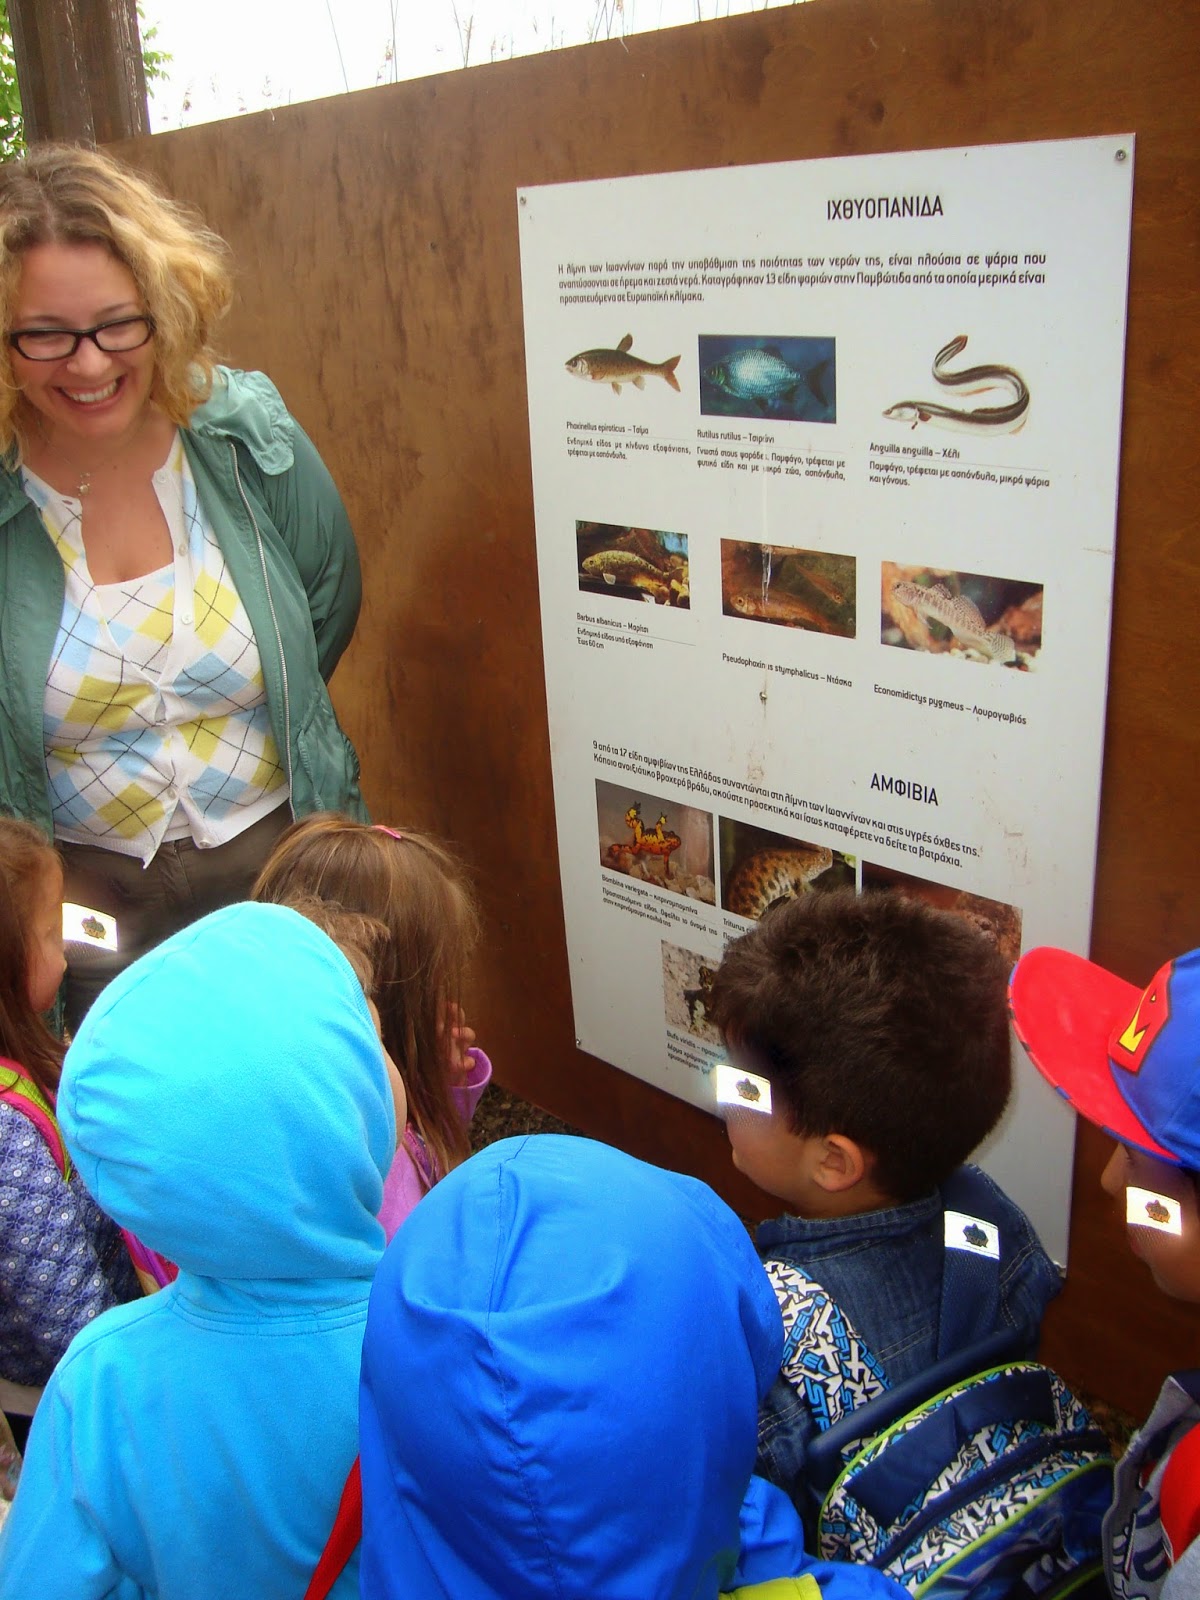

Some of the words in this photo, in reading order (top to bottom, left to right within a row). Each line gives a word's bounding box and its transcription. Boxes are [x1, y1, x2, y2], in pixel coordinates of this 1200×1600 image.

[827, 195, 944, 220] ΙΧΘΥΟΠΑΝΙΔΑ
[558, 264, 564, 275] Η
[566, 263, 587, 277] λίμνη
[589, 264, 603, 273] των
[606, 260, 645, 272] Ιωαννίνων
[648, 259, 668, 273] παρά
[672, 261, 685, 270] την
[688, 257, 738, 272] υποβάθμιση
[742, 259, 756, 268] της
[760, 256, 803, 268] ποιότητας
[807, 258, 825, 267] των
[829, 254, 861, 270] νερών
[865, 257, 884, 268] της,
[889, 254, 912, 266] είναι
[918, 253, 961, 266] πλούσια
[966, 255, 980, 265] σε
[985, 253, 1018, 269] ψάρια
[1024, 254, 1046, 265] που
[559, 278, 610, 289] αναπτύσσονται
[610, 279, 619, 287] σε
[619, 276, 643, 290] ήρεμα
[644, 278, 656, 286] και
[657, 274, 678, 286] ζεστά
[679, 274, 701, 288] νερά.
[701, 273, 765, 288] Καταγράφηκαν
[766, 273, 776, 284] 13
[777, 272, 797, 285] είδη
[797, 272, 833, 287] ψαριών
[834, 275, 856, 284] στην
[857, 272, 911, 287] Παμβώτιδα
[913, 272, 933, 284] από
[934, 274, 945, 284] τα
[946, 272, 977, 284] οποία
[978, 272, 1017, 287] μερικά
[1018, 272, 1045, 284] είναι
[560, 292, 617, 306] προστατευόμενα
[617, 294, 626, 302] σε
[626, 290, 669, 305] Ευρωπαϊκή
[670, 290, 705, 304] κλίμακα.
[697, 429, 719, 440] Rutilus
[720, 432, 741, 441] rutilus
[740, 451, 769, 462] ψαράδε.
[869, 442, 901, 455] Anguilla
[902, 446, 933, 458] anguilla
[942, 448, 960, 459] Χέλι
[869, 461, 906, 474] Παμφάγο,
[907, 465, 939, 477] τρέφεται
[940, 470, 950, 479] με
[951, 469, 998, 483] ασπόνδυλα,
[999, 475, 1024, 486] μικρά
[1025, 476, 1050, 489] ψάρια
[882, 475, 910, 486] γόνους.
[775, 665, 819, 681] stymphalicus
[874, 684, 927, 705] Economidictys
[928, 698, 964, 711] pygmeus
[972, 705, 1027, 725] Λουρογωβιός
[593, 740, 599, 750] 9
[598, 744, 611, 755] από
[610, 747, 619, 755] τα
[628, 750, 643, 762] είδη
[644, 756, 678, 771] αμφιβίων
[677, 765, 689, 775] της
[689, 766, 721, 784] Ελλάδας
[722, 778, 770, 798] συναντώνται
[770, 791, 784, 802] στη
[785, 793, 808, 808] λίμνη
[809, 802, 825, 813] των
[825, 804, 871, 826] Ιωαννίνων
[872, 820, 886, 830] και
[887, 824, 904, 836] στις
[905, 829, 932, 844] υγρές
[933, 835, 961, 852] όχθες
[962, 845, 980, 858] της.
[871, 773, 938, 806] ΑΜΦΙΒΙΑ
[593, 753, 619, 767] Κάποιο
[618, 762, 656, 779] ανοιξιάτικο
[656, 770, 686, 788] βροχερό
[687, 779, 712, 796] βράδυ,
[712, 789, 743, 804] ακούστε
[744, 797, 789, 817] προσεκτικά
[790, 811, 803, 821] και
[803, 812, 823, 827] ίσως
[824, 821, 873, 841] καταφέρετε
[873, 835, 885, 845] να
[885, 836, 907, 852] δείτε
[908, 845, 918, 855] τα
[919, 846, 963, 868] βατράχια.
[784, 1303, 816, 1365] STEEL
